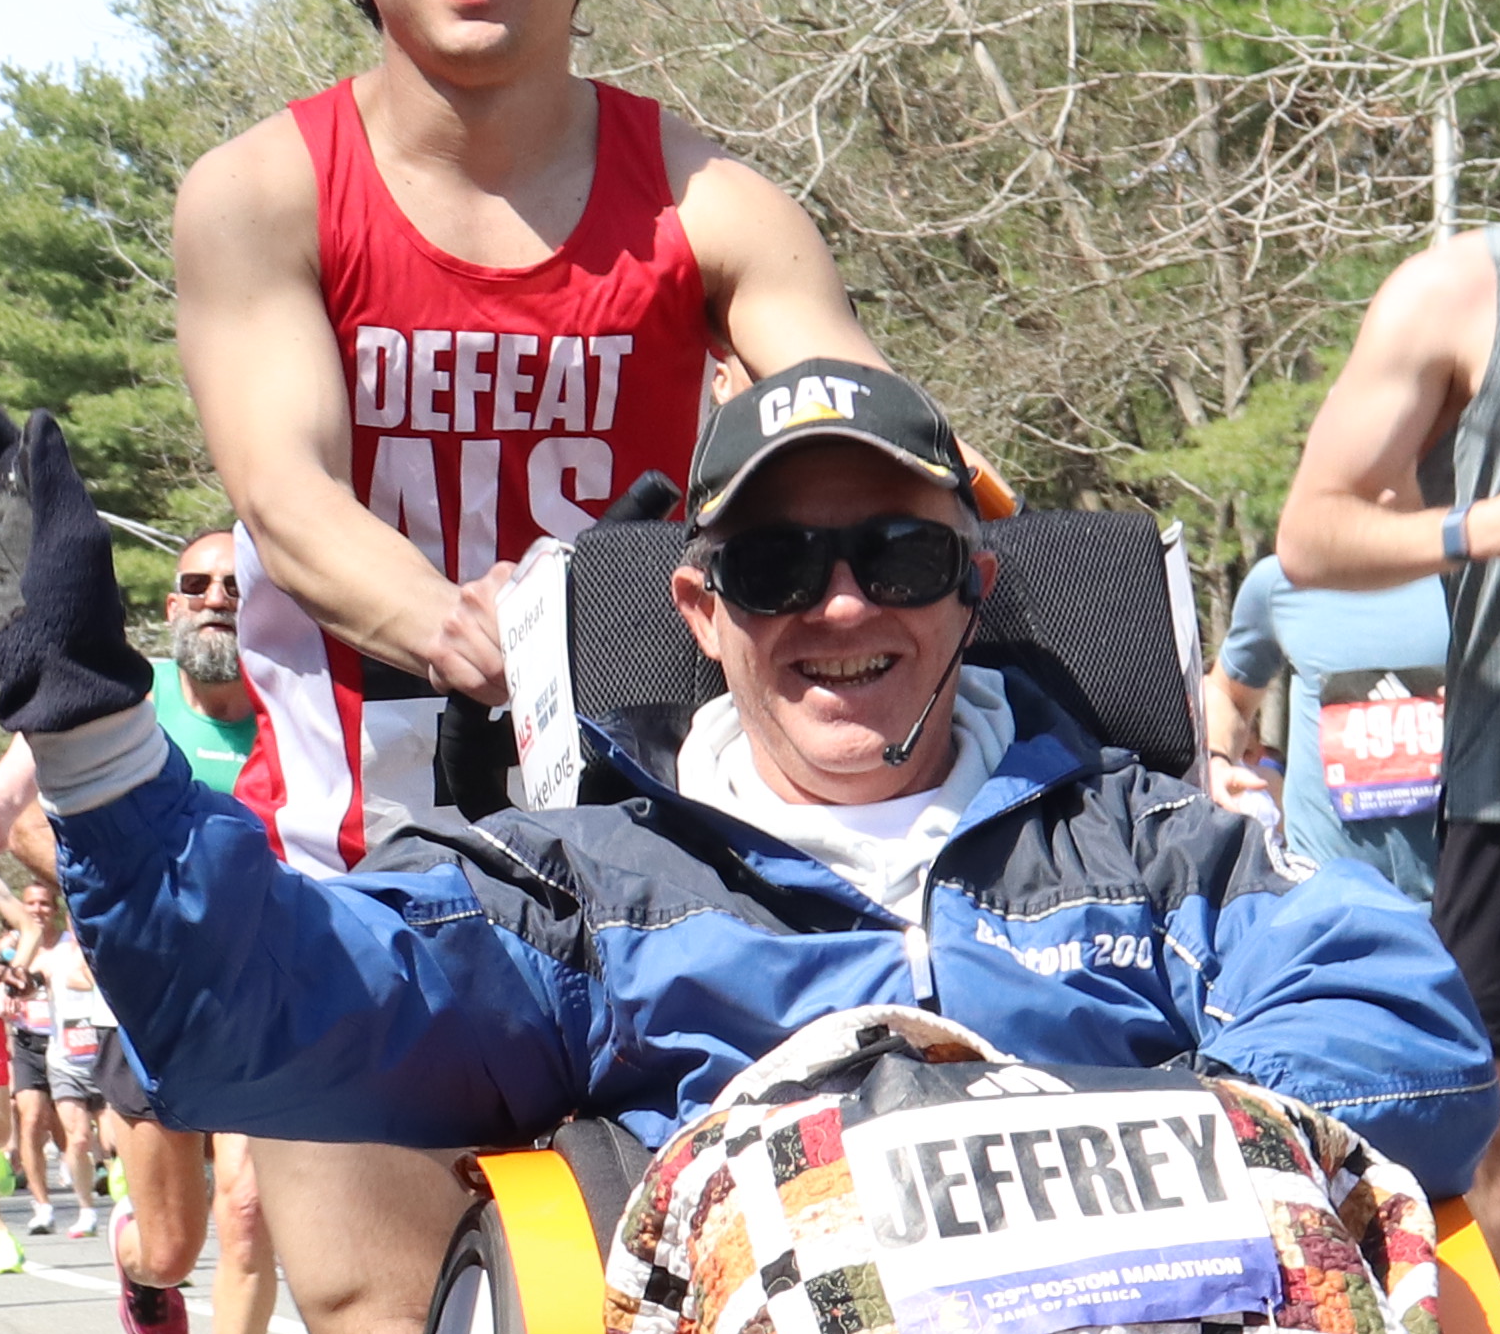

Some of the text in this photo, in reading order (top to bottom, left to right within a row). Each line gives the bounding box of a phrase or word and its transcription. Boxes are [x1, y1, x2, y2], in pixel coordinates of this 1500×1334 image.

[355, 325, 634, 433] DEFEAT
[758, 375, 860, 438] CAT
[508, 595, 546, 653] Defeat
[870, 1113, 1229, 1249] JEFFREY
[990, 1288, 1142, 1325] BANK OF AMERICA
[1031, 1269, 1120, 1300] BOSTON
[1121, 1256, 1244, 1285] MARATHON
